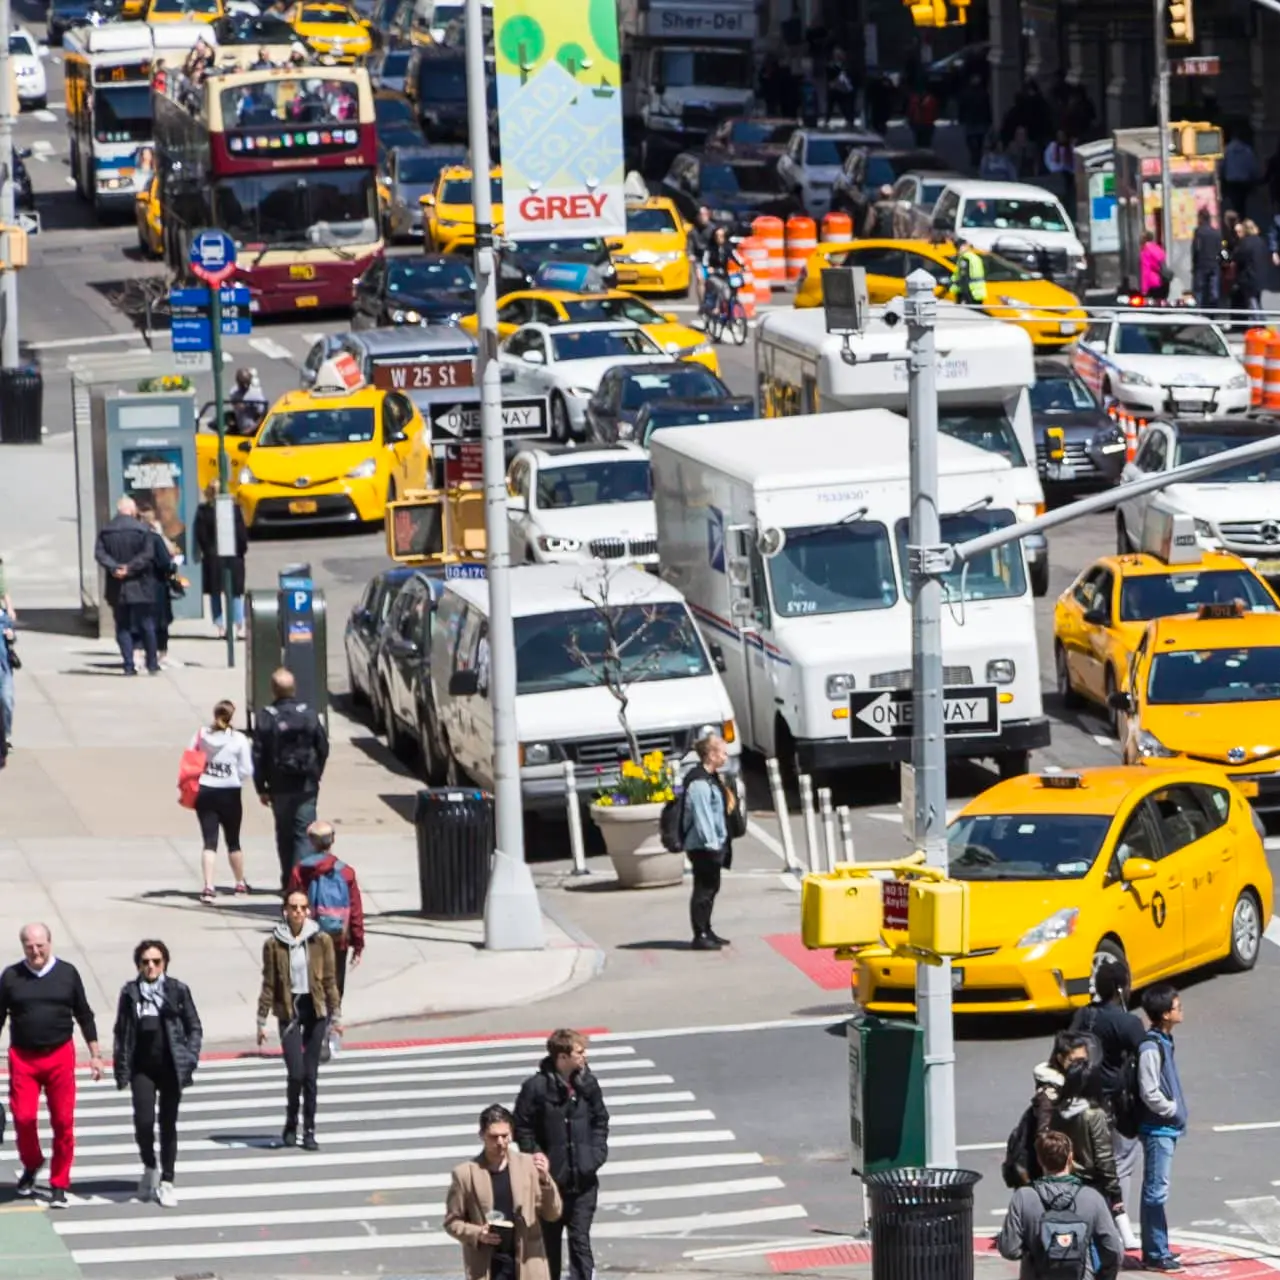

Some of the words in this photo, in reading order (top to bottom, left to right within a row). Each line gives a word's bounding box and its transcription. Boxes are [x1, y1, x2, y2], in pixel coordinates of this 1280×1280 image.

[662, 11, 743, 30] Sher-Del
[519, 193, 608, 221] GREY
[391, 368, 407, 388] W
[413, 366, 432, 387] 25
[439, 365, 456, 386] St
[873, 704, 914, 724] ONE
